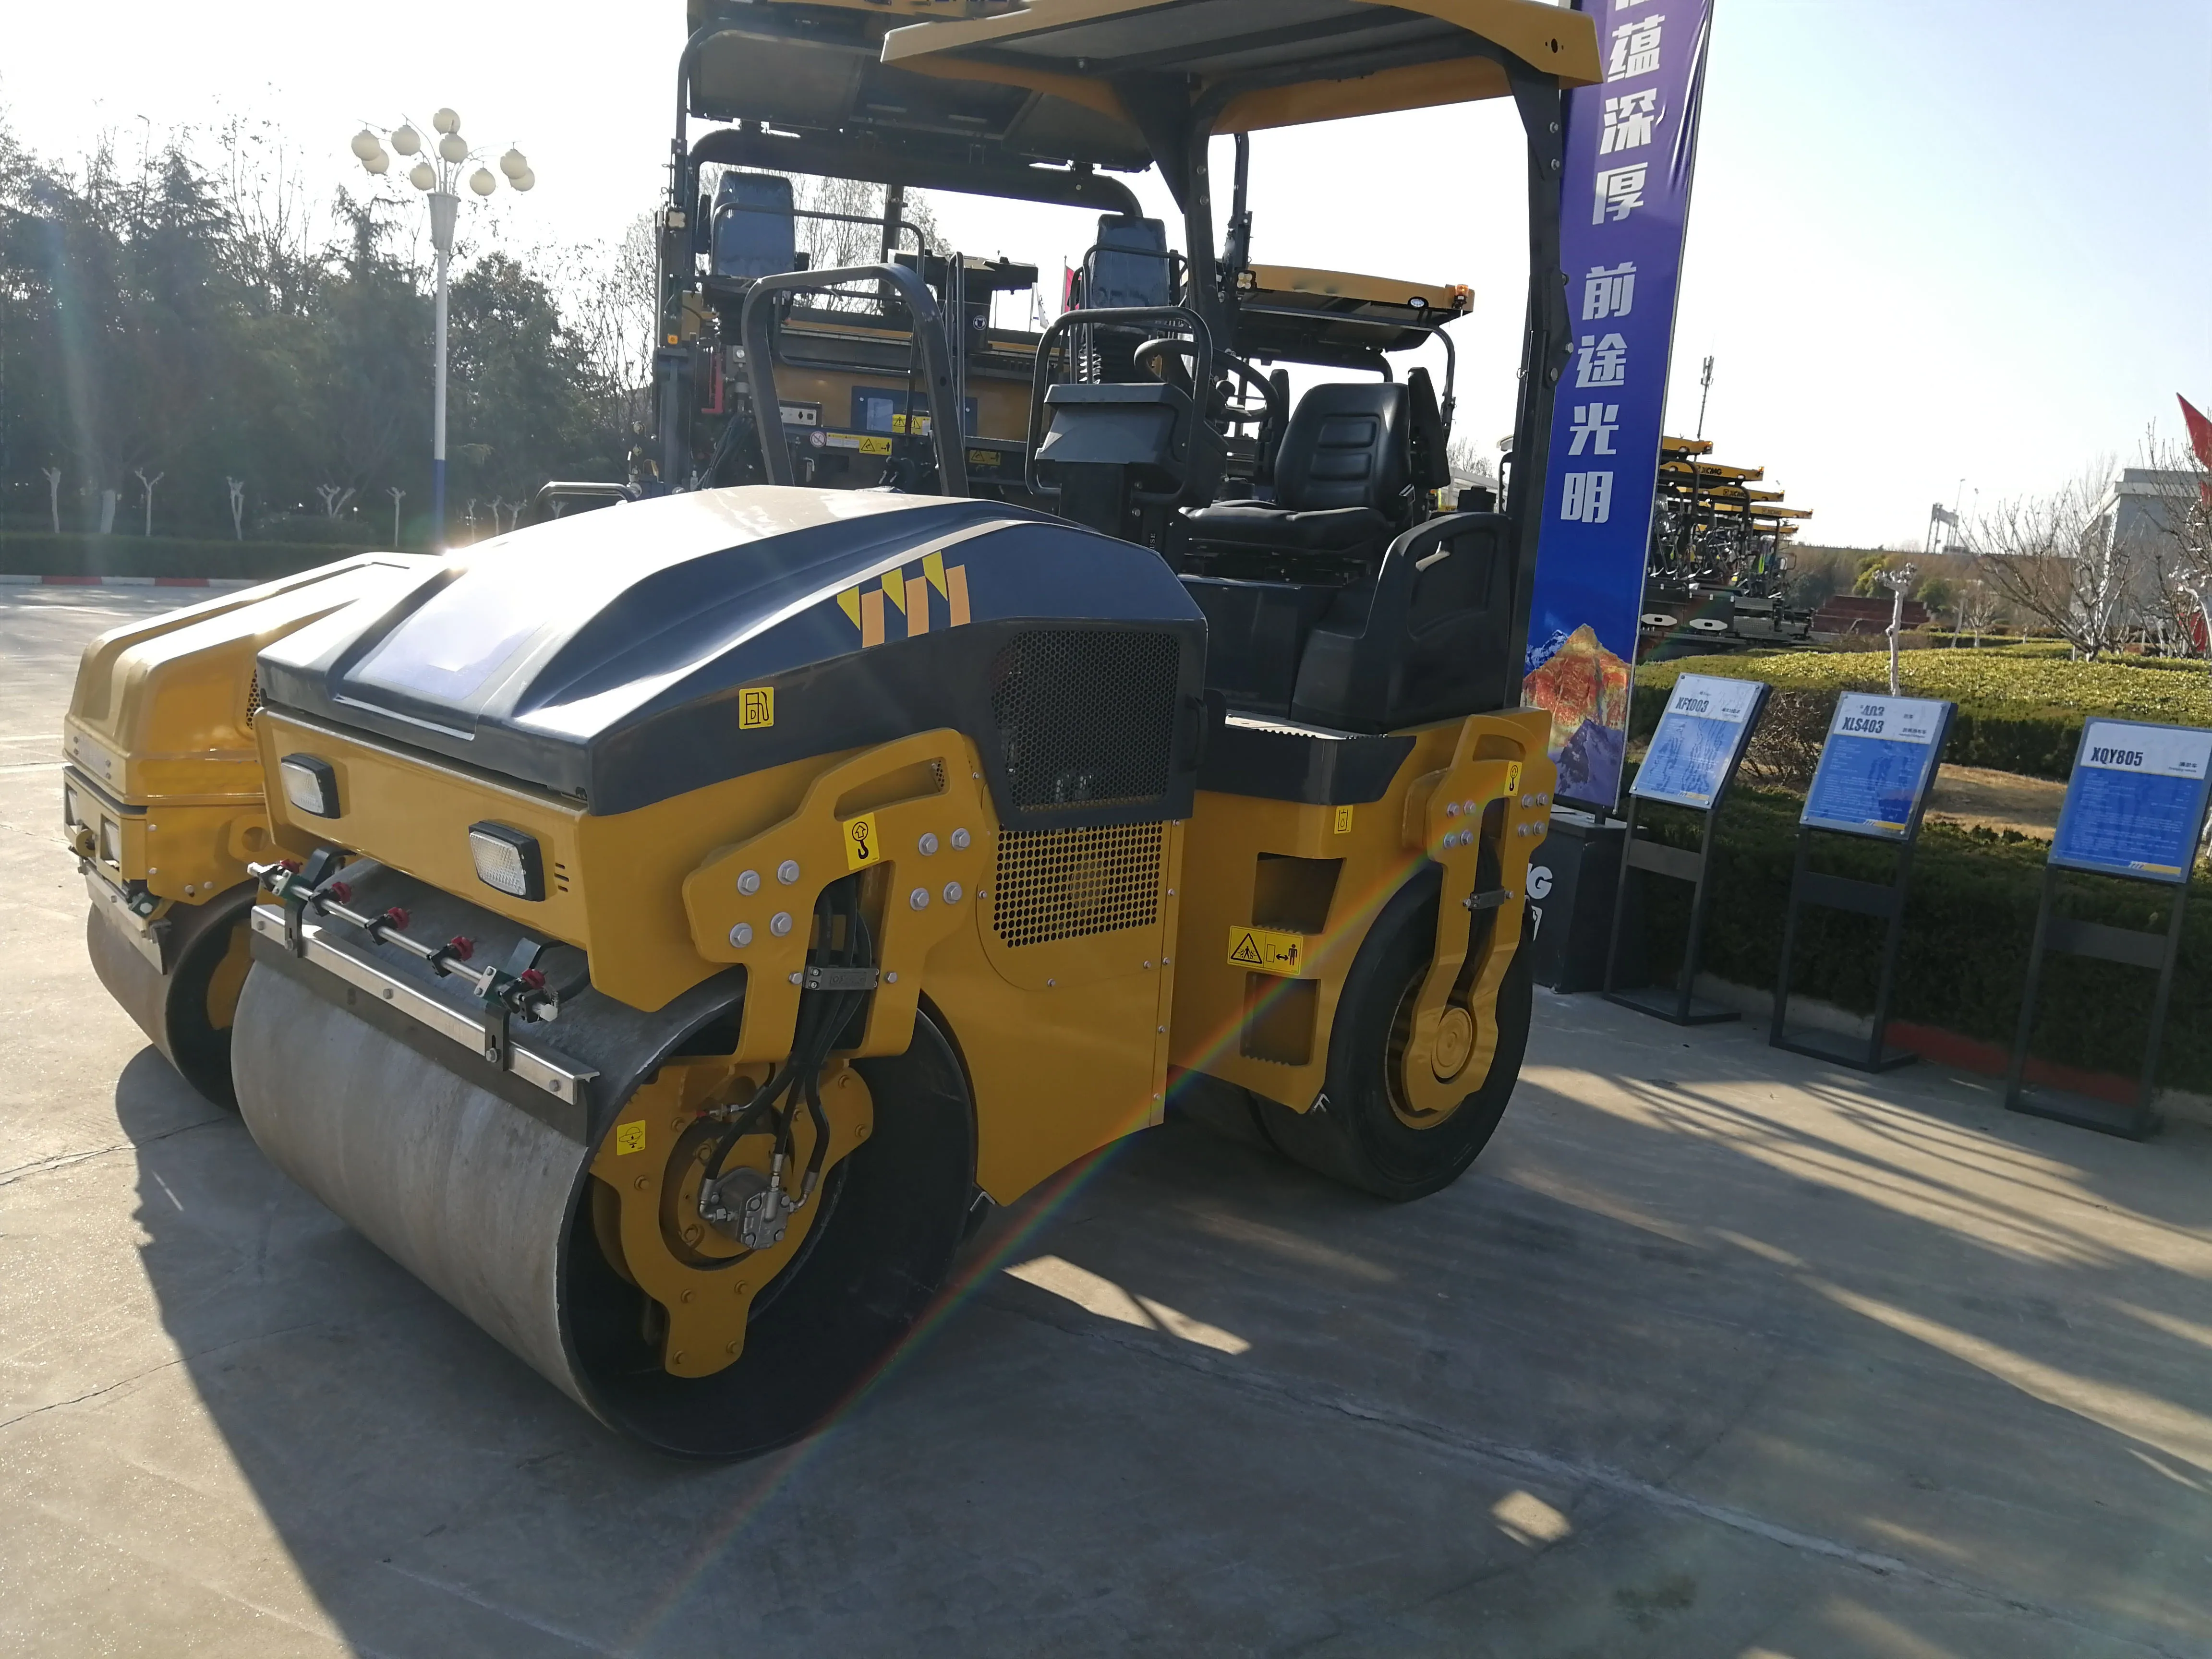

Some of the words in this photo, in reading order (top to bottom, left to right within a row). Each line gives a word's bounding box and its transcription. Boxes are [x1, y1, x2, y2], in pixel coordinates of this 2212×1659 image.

[1592, 0, 1665, 225] 蕴深厚
[1560, 261, 1637, 523] 前途光明
[1675, 697, 1709, 712] XF1003
[1842, 717, 1885, 733] XLS403
[2091, 747, 2143, 766] XQY805
